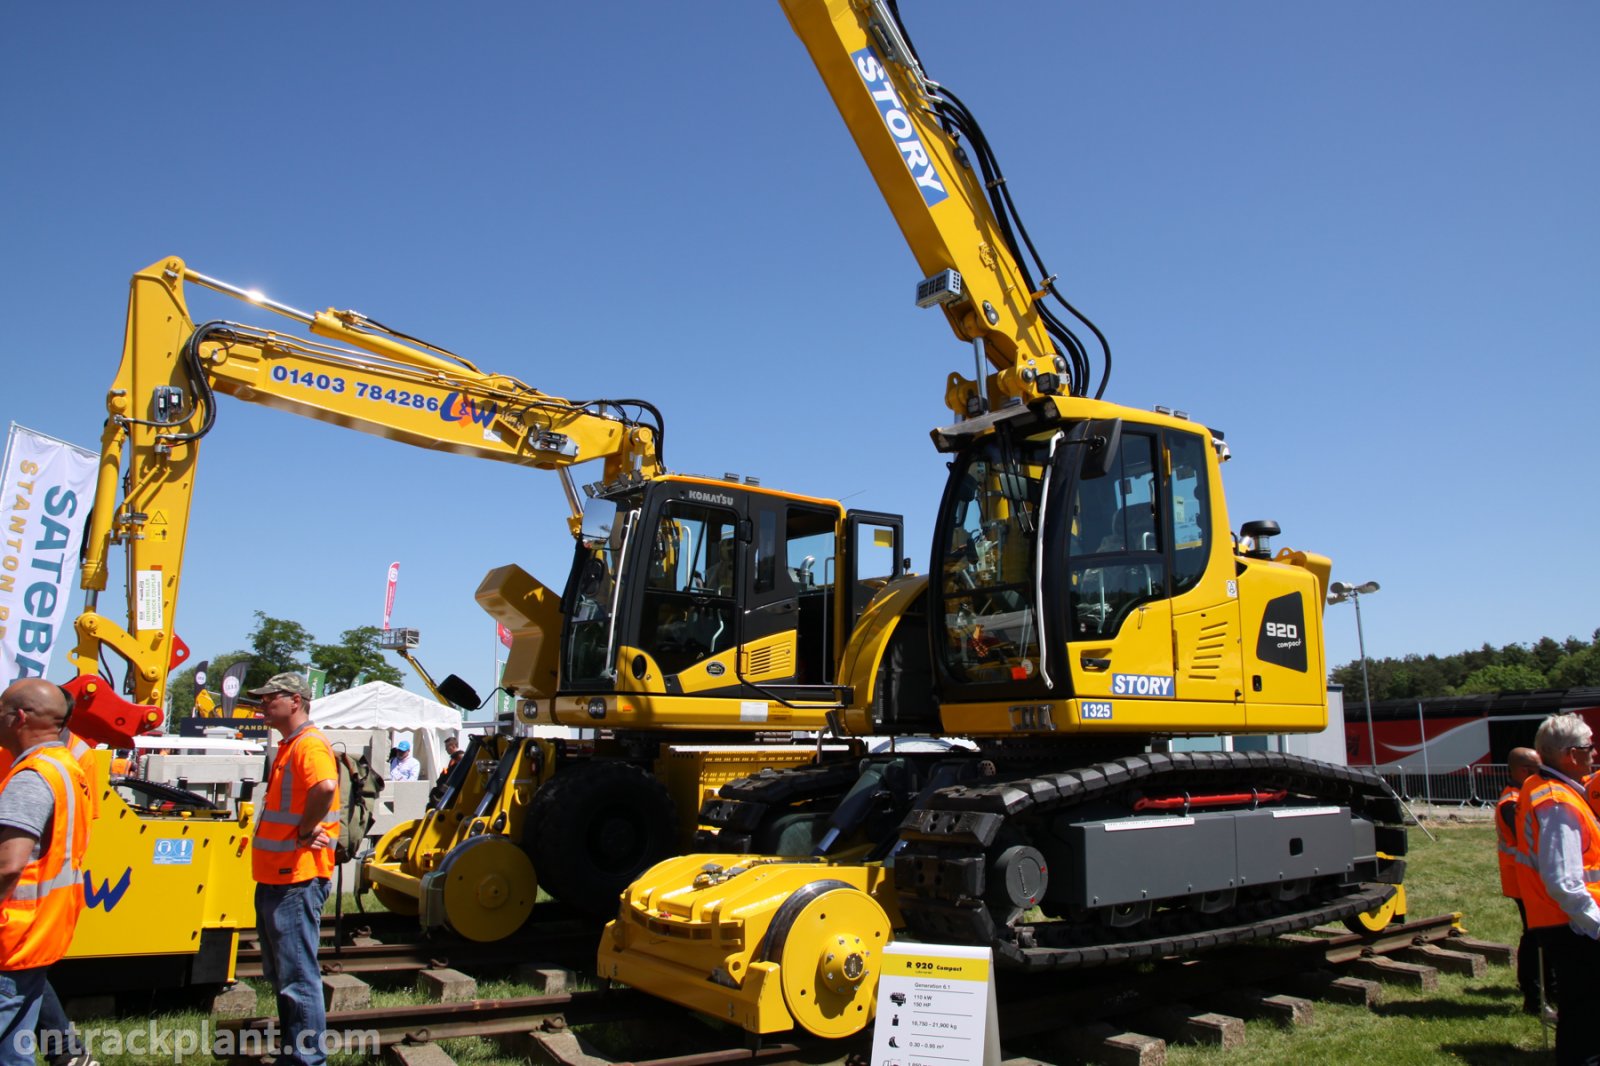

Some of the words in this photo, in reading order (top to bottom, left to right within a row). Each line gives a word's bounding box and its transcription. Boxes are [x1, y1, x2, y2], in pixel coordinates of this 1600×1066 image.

[857, 56, 945, 193] STORY
[272, 365, 346, 394] 01403
[356, 382, 439, 412] 784286
[688, 490, 734, 506] KOMATSU
[0, 459, 39, 593] STANTON
[1266, 622, 1298, 638] 920
[1277, 639, 1302, 649] compact
[1114, 675, 1172, 696] STORY
[1082, 703, 1111, 718] 1325
[906, 961, 913, 969] R
[915, 962, 933, 970] 920
